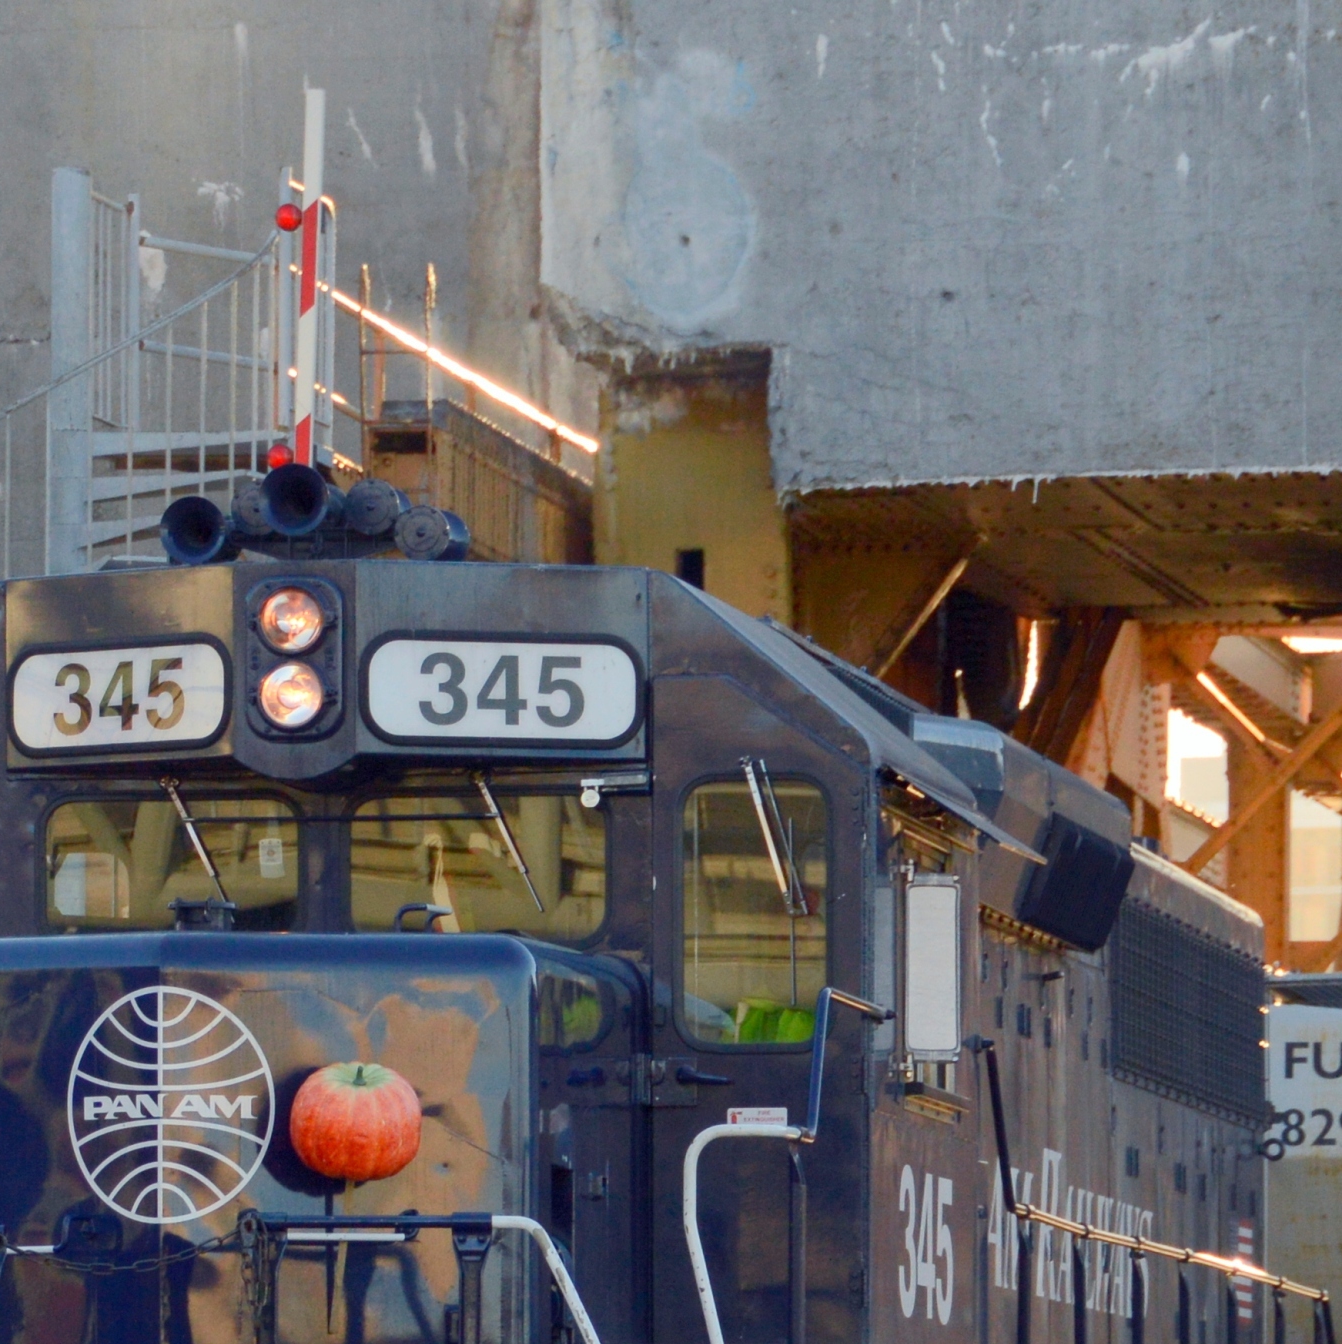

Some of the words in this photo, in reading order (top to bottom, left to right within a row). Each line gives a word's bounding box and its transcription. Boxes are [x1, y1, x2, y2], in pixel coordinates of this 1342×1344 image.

[53, 658, 185, 736] 345
[418, 652, 585, 727] 345
[83, 1093, 168, 1121] PAN
[170, 1094, 258, 1120] AM
[898, 1164, 954, 1326] 345
